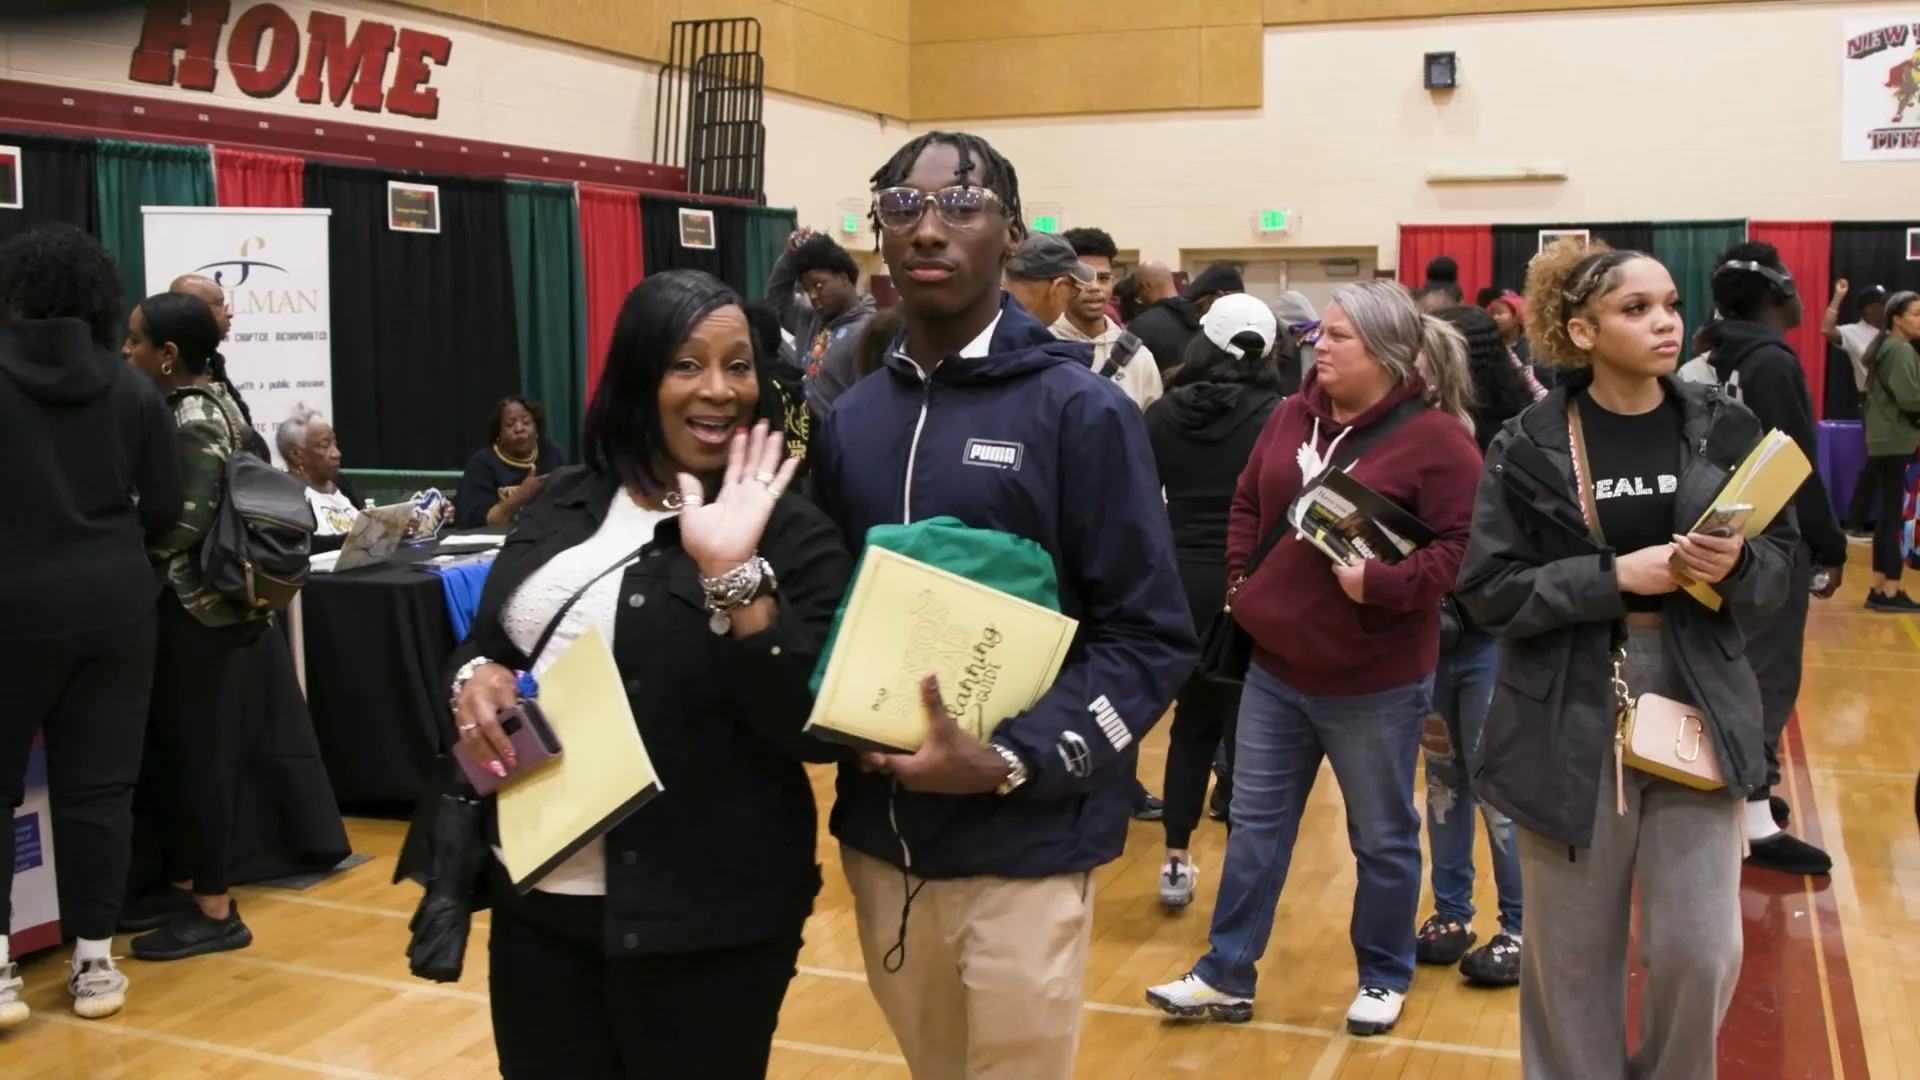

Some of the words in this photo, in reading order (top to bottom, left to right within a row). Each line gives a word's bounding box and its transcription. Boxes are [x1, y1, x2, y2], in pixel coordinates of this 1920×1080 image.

[1846, 23, 1909, 60] NEW
[129, 0, 453, 119] HOME
[1867, 130, 1920, 151] TITA
[226, 288, 319, 315] LMAN
[268, 380, 291, 391] public
[969, 443, 1017, 465] PUMA
[1591, 477, 1653, 500] EAL
[979, 661, 1002, 703] GUIDE
[1087, 694, 1133, 753] PUMA
